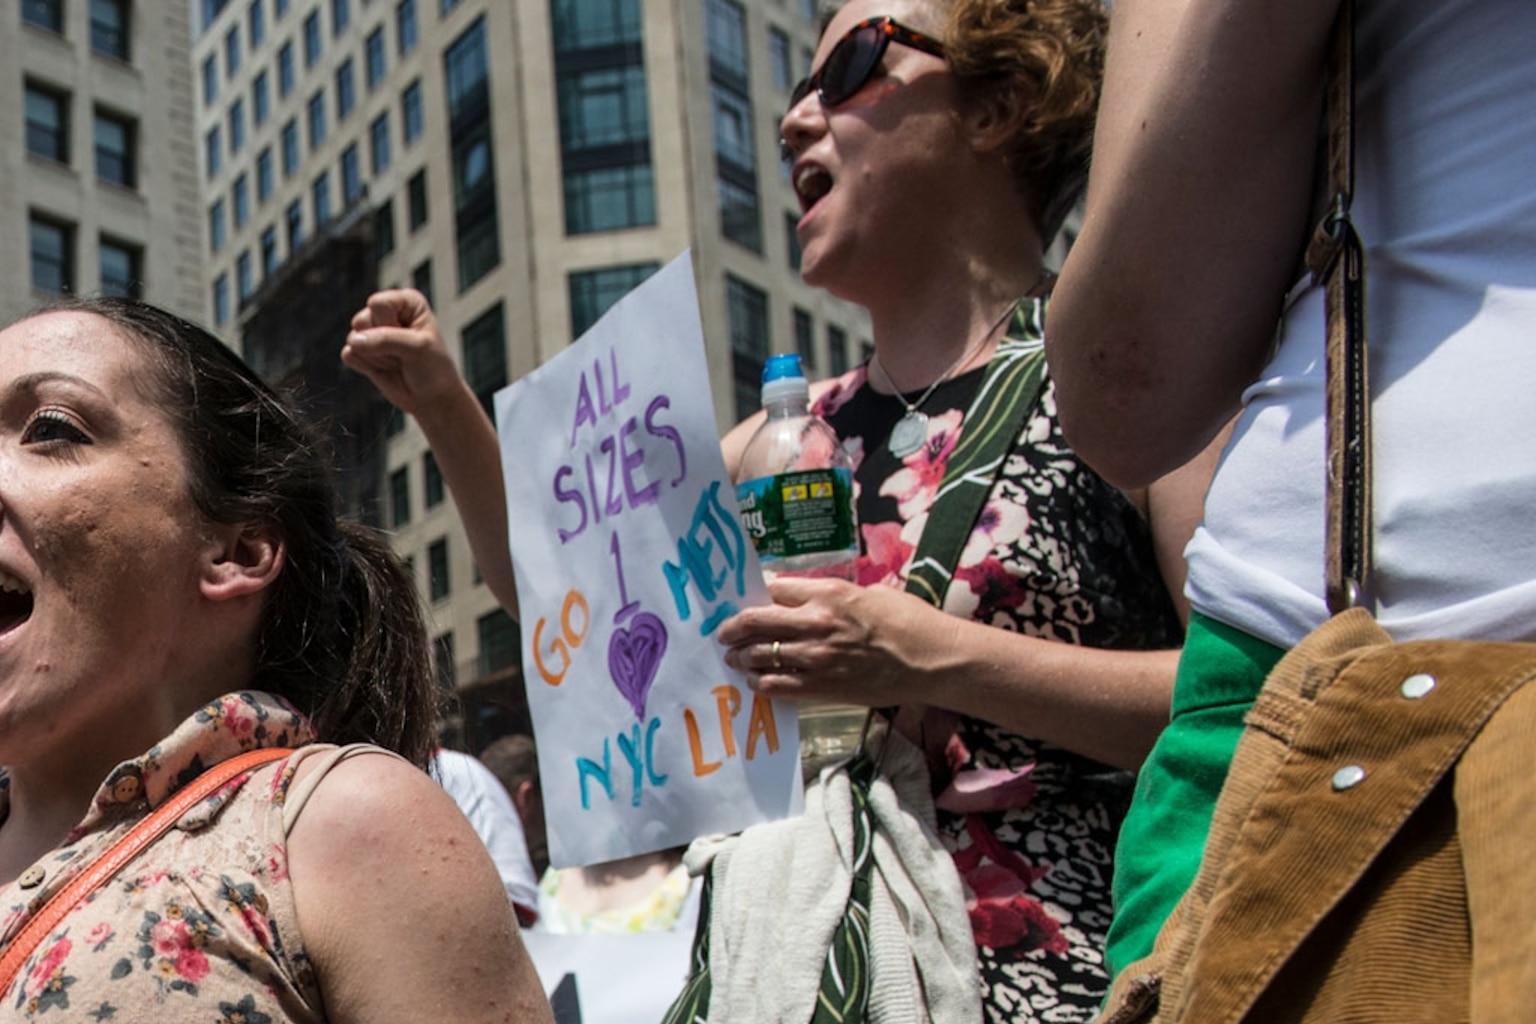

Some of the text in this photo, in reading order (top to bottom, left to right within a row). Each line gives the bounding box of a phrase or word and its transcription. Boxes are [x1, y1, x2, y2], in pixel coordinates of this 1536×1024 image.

[570, 346, 631, 449] ALL
[553, 394, 686, 545] SIZES
[532, 587, 590, 687] GO
[576, 684, 780, 811] NYC LPA
